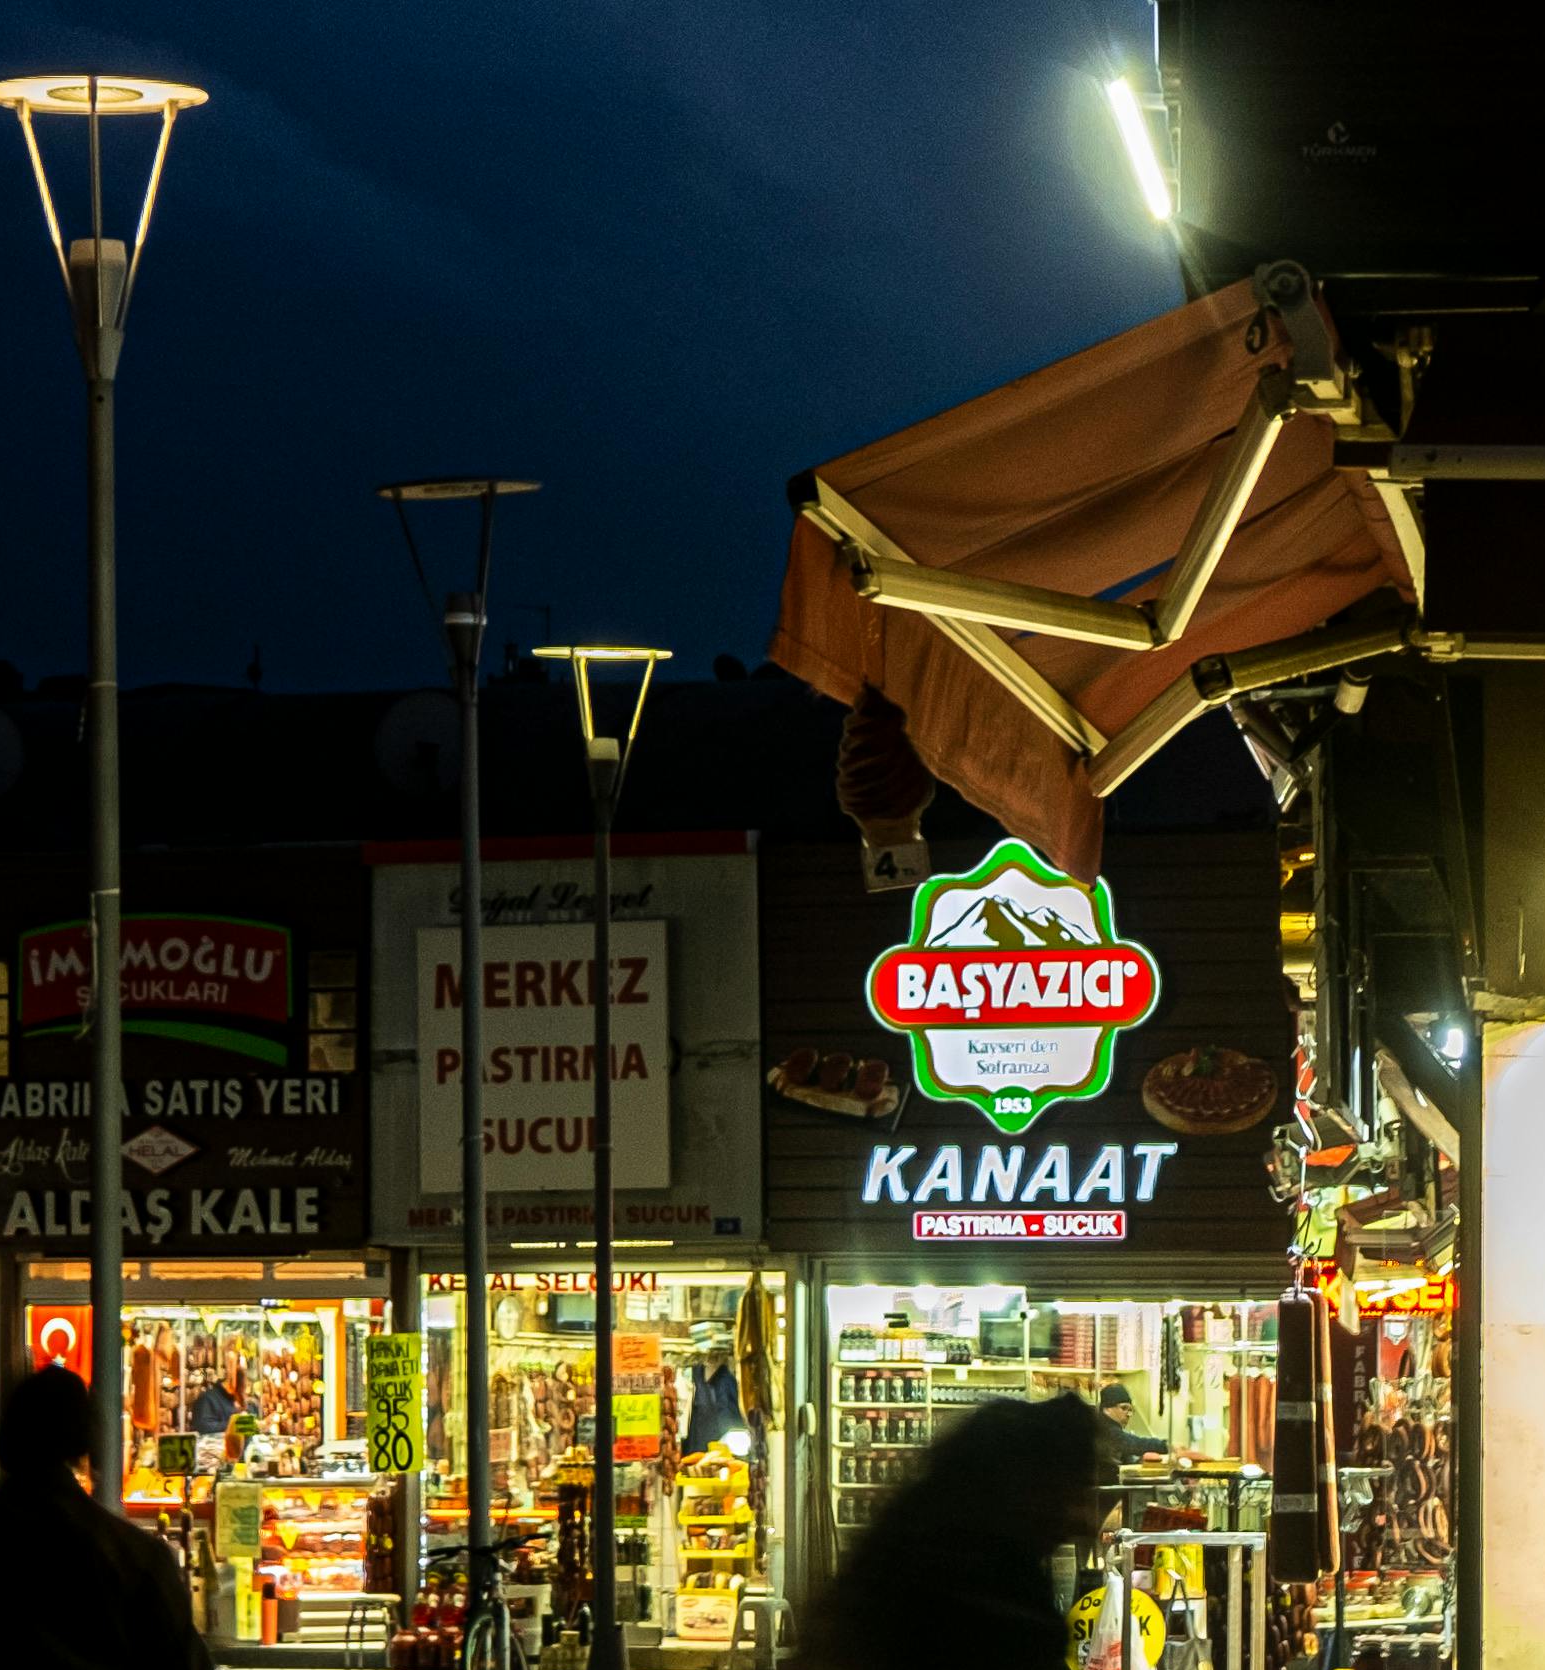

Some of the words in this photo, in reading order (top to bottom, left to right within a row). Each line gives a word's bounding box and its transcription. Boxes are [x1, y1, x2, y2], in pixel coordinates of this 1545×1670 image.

[875, 852, 897, 879] 4
[28, 936, 275, 988] İMMOĞLU
[75, 979, 229, 1009] SCUKLARI
[896, 959, 1126, 1019] BAŞYAZICI
[436, 1044, 649, 1085] PSTIRMA
[143, 1078, 245, 1120] SATIŞ
[256, 1076, 341, 1115] YERİ
[993, 1097, 1032, 1114] 1953
[481, 1117, 597, 1155] SUCU
[861, 1142, 1179, 1202] KANAAT
[191, 1186, 321, 1235] KALE
[626, 1204, 711, 1225] SUCUK
[920, 1214, 1028, 1237] PASTIRMA
[1044, 1214, 1120, 1237] SUCUK
[428, 1271, 524, 1291] KEAL
[370, 1379, 414, 1401] SUCUK
[375, 1397, 410, 1432] 95
[374, 1428, 414, 1472] 80
